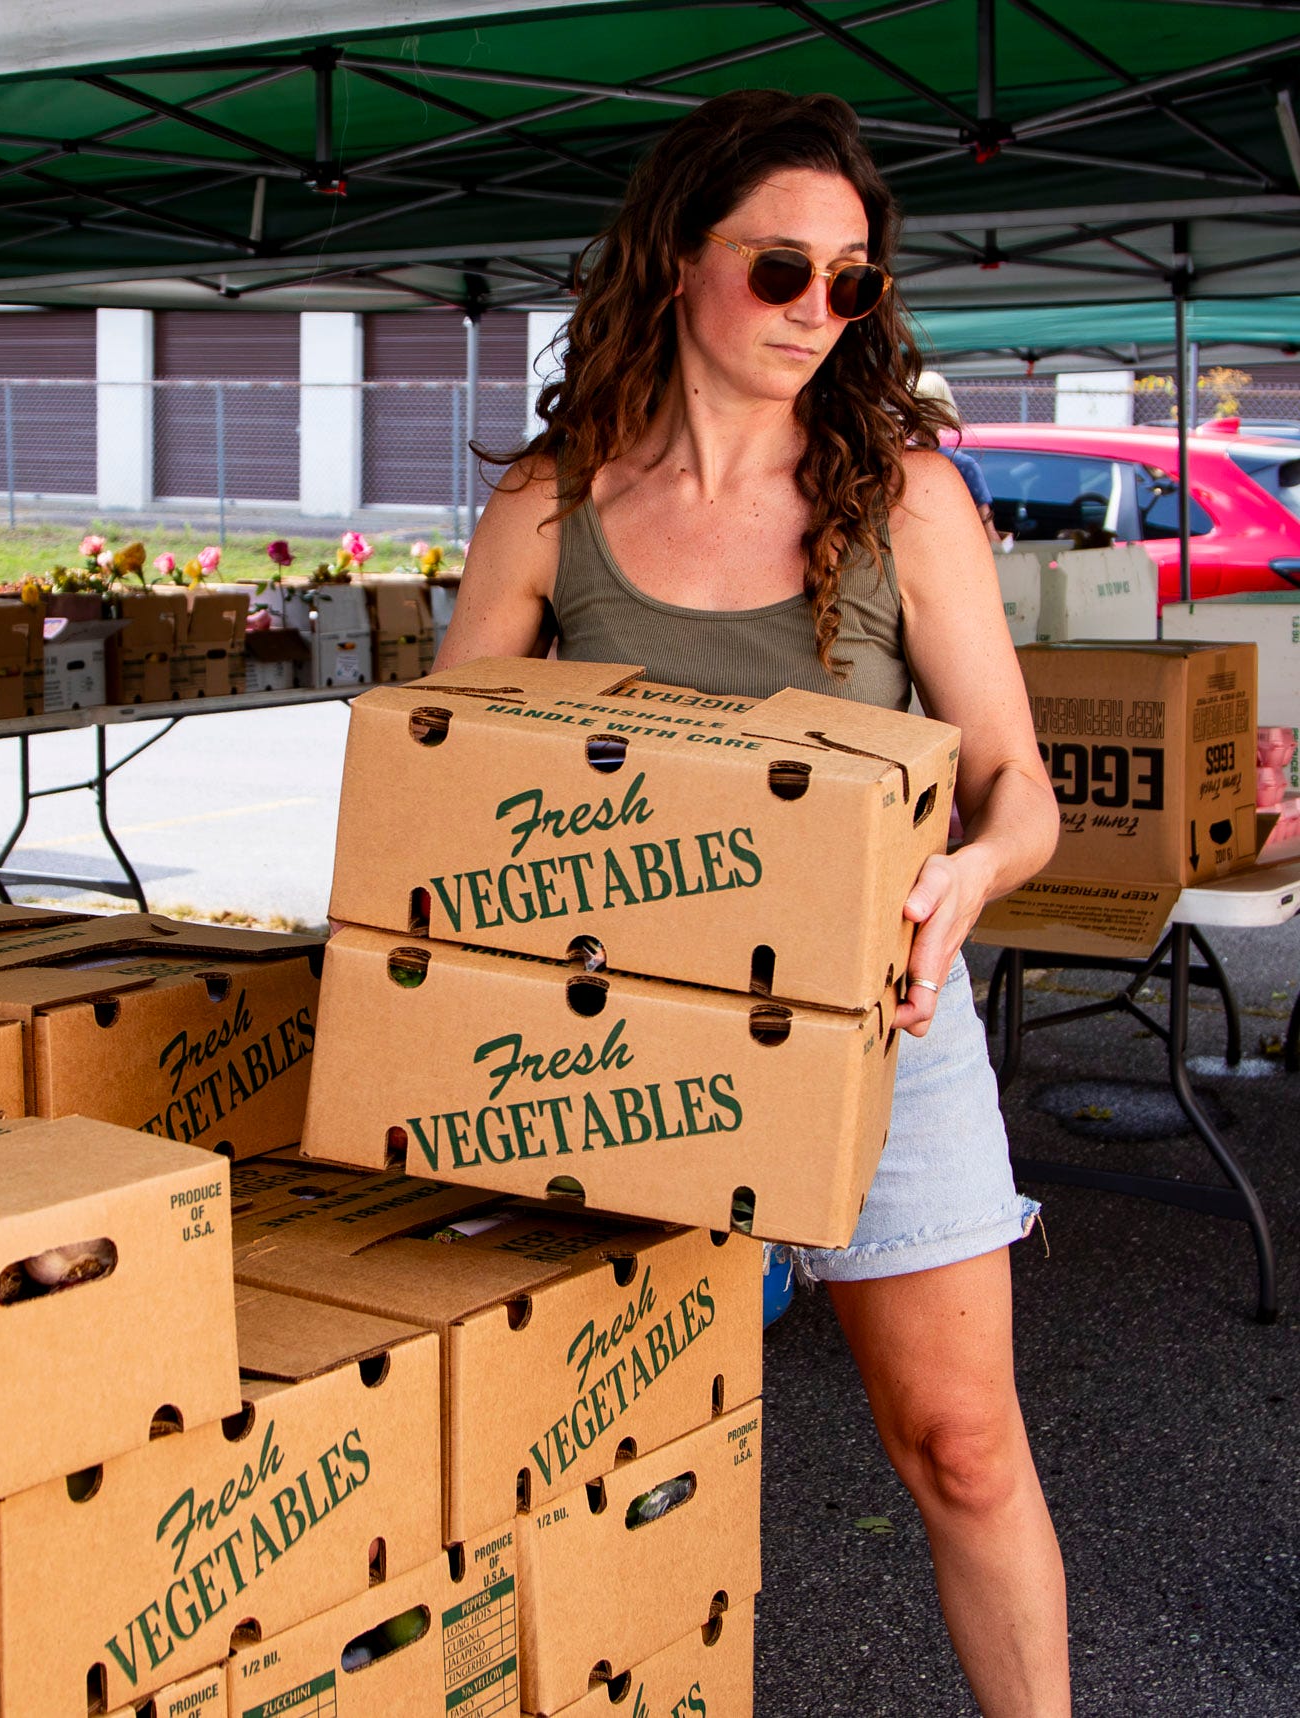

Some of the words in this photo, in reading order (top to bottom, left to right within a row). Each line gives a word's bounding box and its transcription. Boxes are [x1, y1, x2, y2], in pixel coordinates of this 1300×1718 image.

[485, 704, 598, 727] HANDLE
[606, 721, 677, 739] WITH
[686, 733, 764, 751] CARE
[555, 700, 728, 729] PERISHABLE
[1028, 696, 1123, 736] REFRIGERAT
[1127, 701, 1165, 739] KEEP
[1206, 741, 1235, 776] EGGS
[495, 772, 654, 859] Fresh
[430, 826, 763, 934] VEGETABLES
[1121, 890, 1159, 902] KEEP
[158, 988, 254, 1096] Fresh
[137, 1005, 316, 1145] GETABLES
[474, 1018, 634, 1101] Fresh
[406, 1073, 743, 1173] VEGETABLES
[169, 1180, 223, 1210] PRODUCE
[190, 1203, 205, 1221] OF
[181, 1220, 216, 1243] U.S.A.
[567, 1264, 657, 1394] Fresh
[529, 1276, 716, 1488] VEGETABLES
[727, 1417, 759, 1444] PRODUCE
[738, 1437, 748, 1450] OF
[733, 1449, 753, 1467] U.S.A.
[156, 1419, 285, 1575] Fresh
[536, 1510, 552, 1530] 1/2
[553, 1506, 570, 1522] BU.
[104, 1427, 372, 1688] VEGETABLES
[474, 1531, 513, 1563] PRODUCE
[489, 1554, 501, 1570] OF
[483, 1566, 508, 1588] U.S.A.
[461, 1590, 492, 1617] PEPPERS
[446, 1618, 470, 1638] LONG
[471, 1607, 492, 1626] HOTS
[241, 1659, 260, 1679] 1/2
[263, 1650, 281, 1670] BU.
[448, 1641, 486, 1669] JALAPENO
[449, 1651, 493, 1685] FINGERHOT
[473, 1664, 503, 1690] YELLOW
[168, 1682, 219, 1718] PRODUCE
[262, 1683, 312, 1718] ZUCCHINI
[450, 1699, 475, 1718] FANCY
